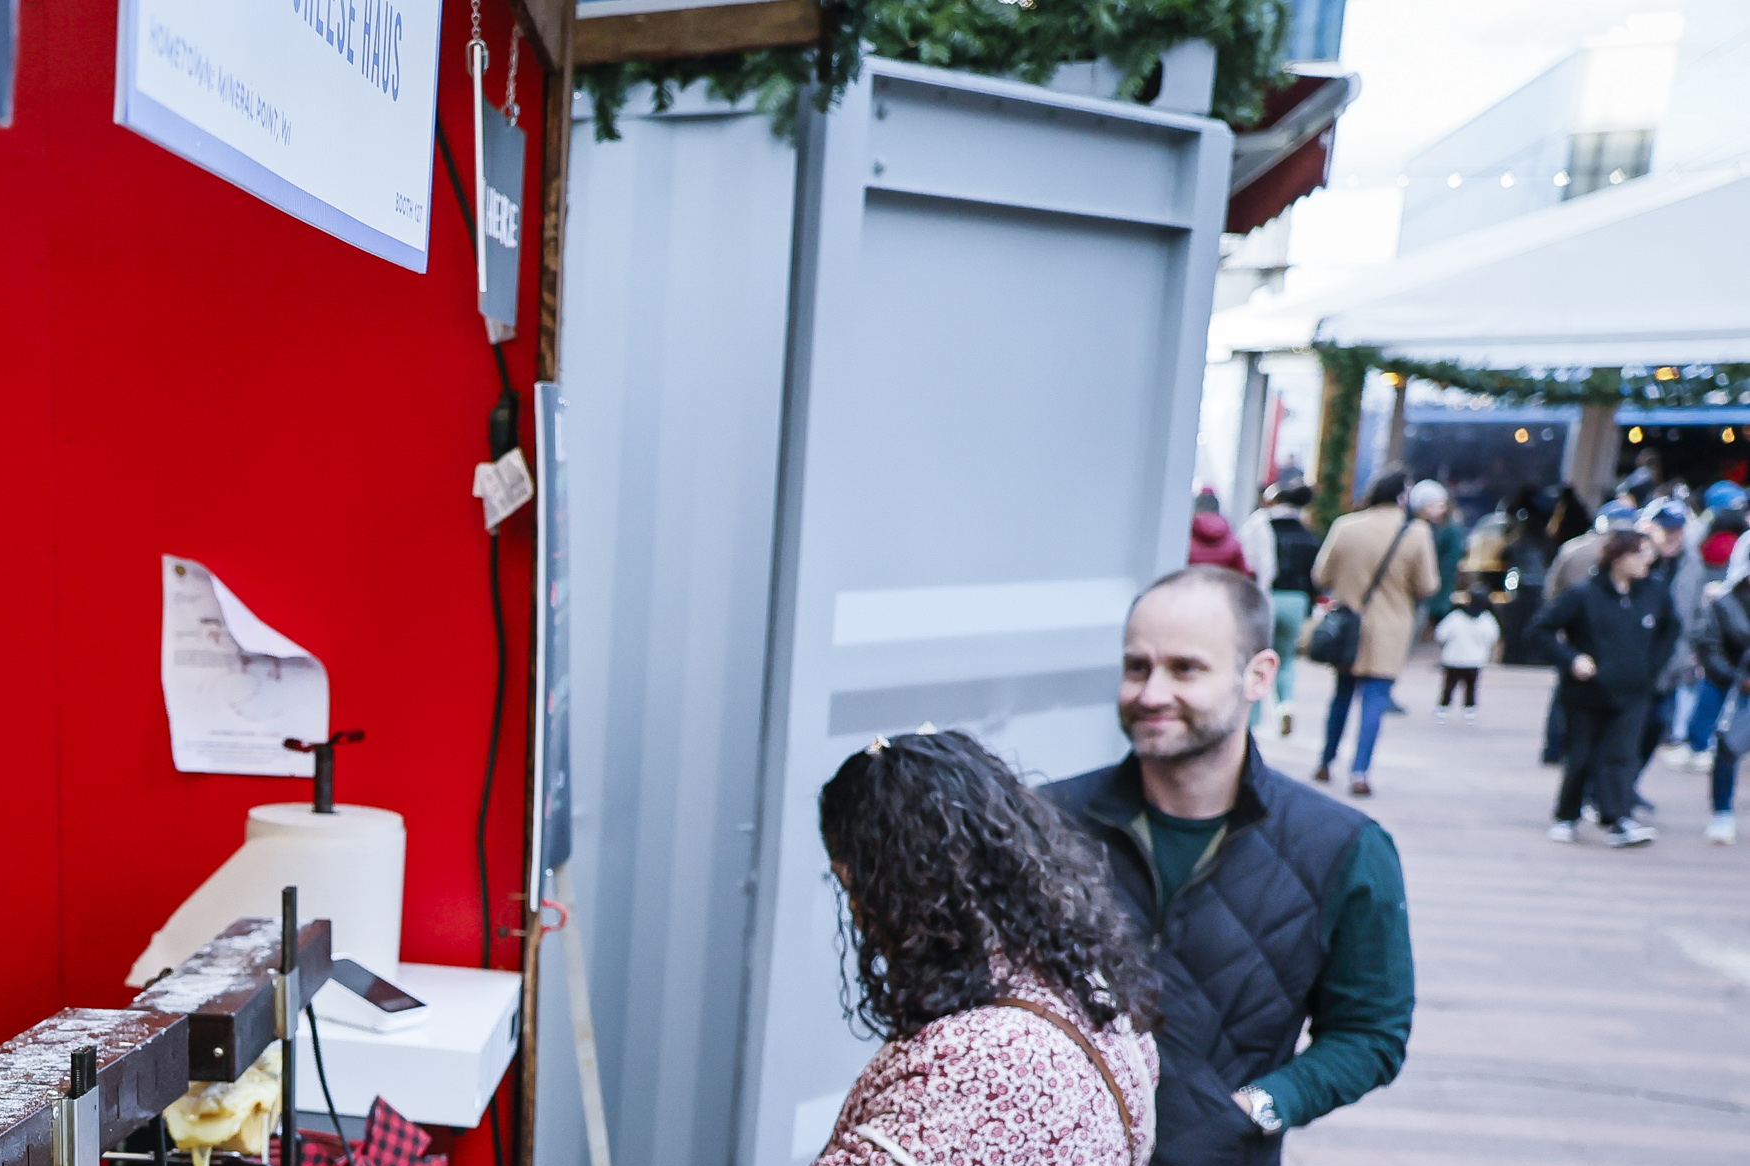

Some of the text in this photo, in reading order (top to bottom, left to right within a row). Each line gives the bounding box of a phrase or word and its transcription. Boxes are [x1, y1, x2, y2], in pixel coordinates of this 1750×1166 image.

[362, 0, 401, 102] HAUS
[218, 64, 254, 122] MINERAL
[395, 192, 412, 219] BOOTH
